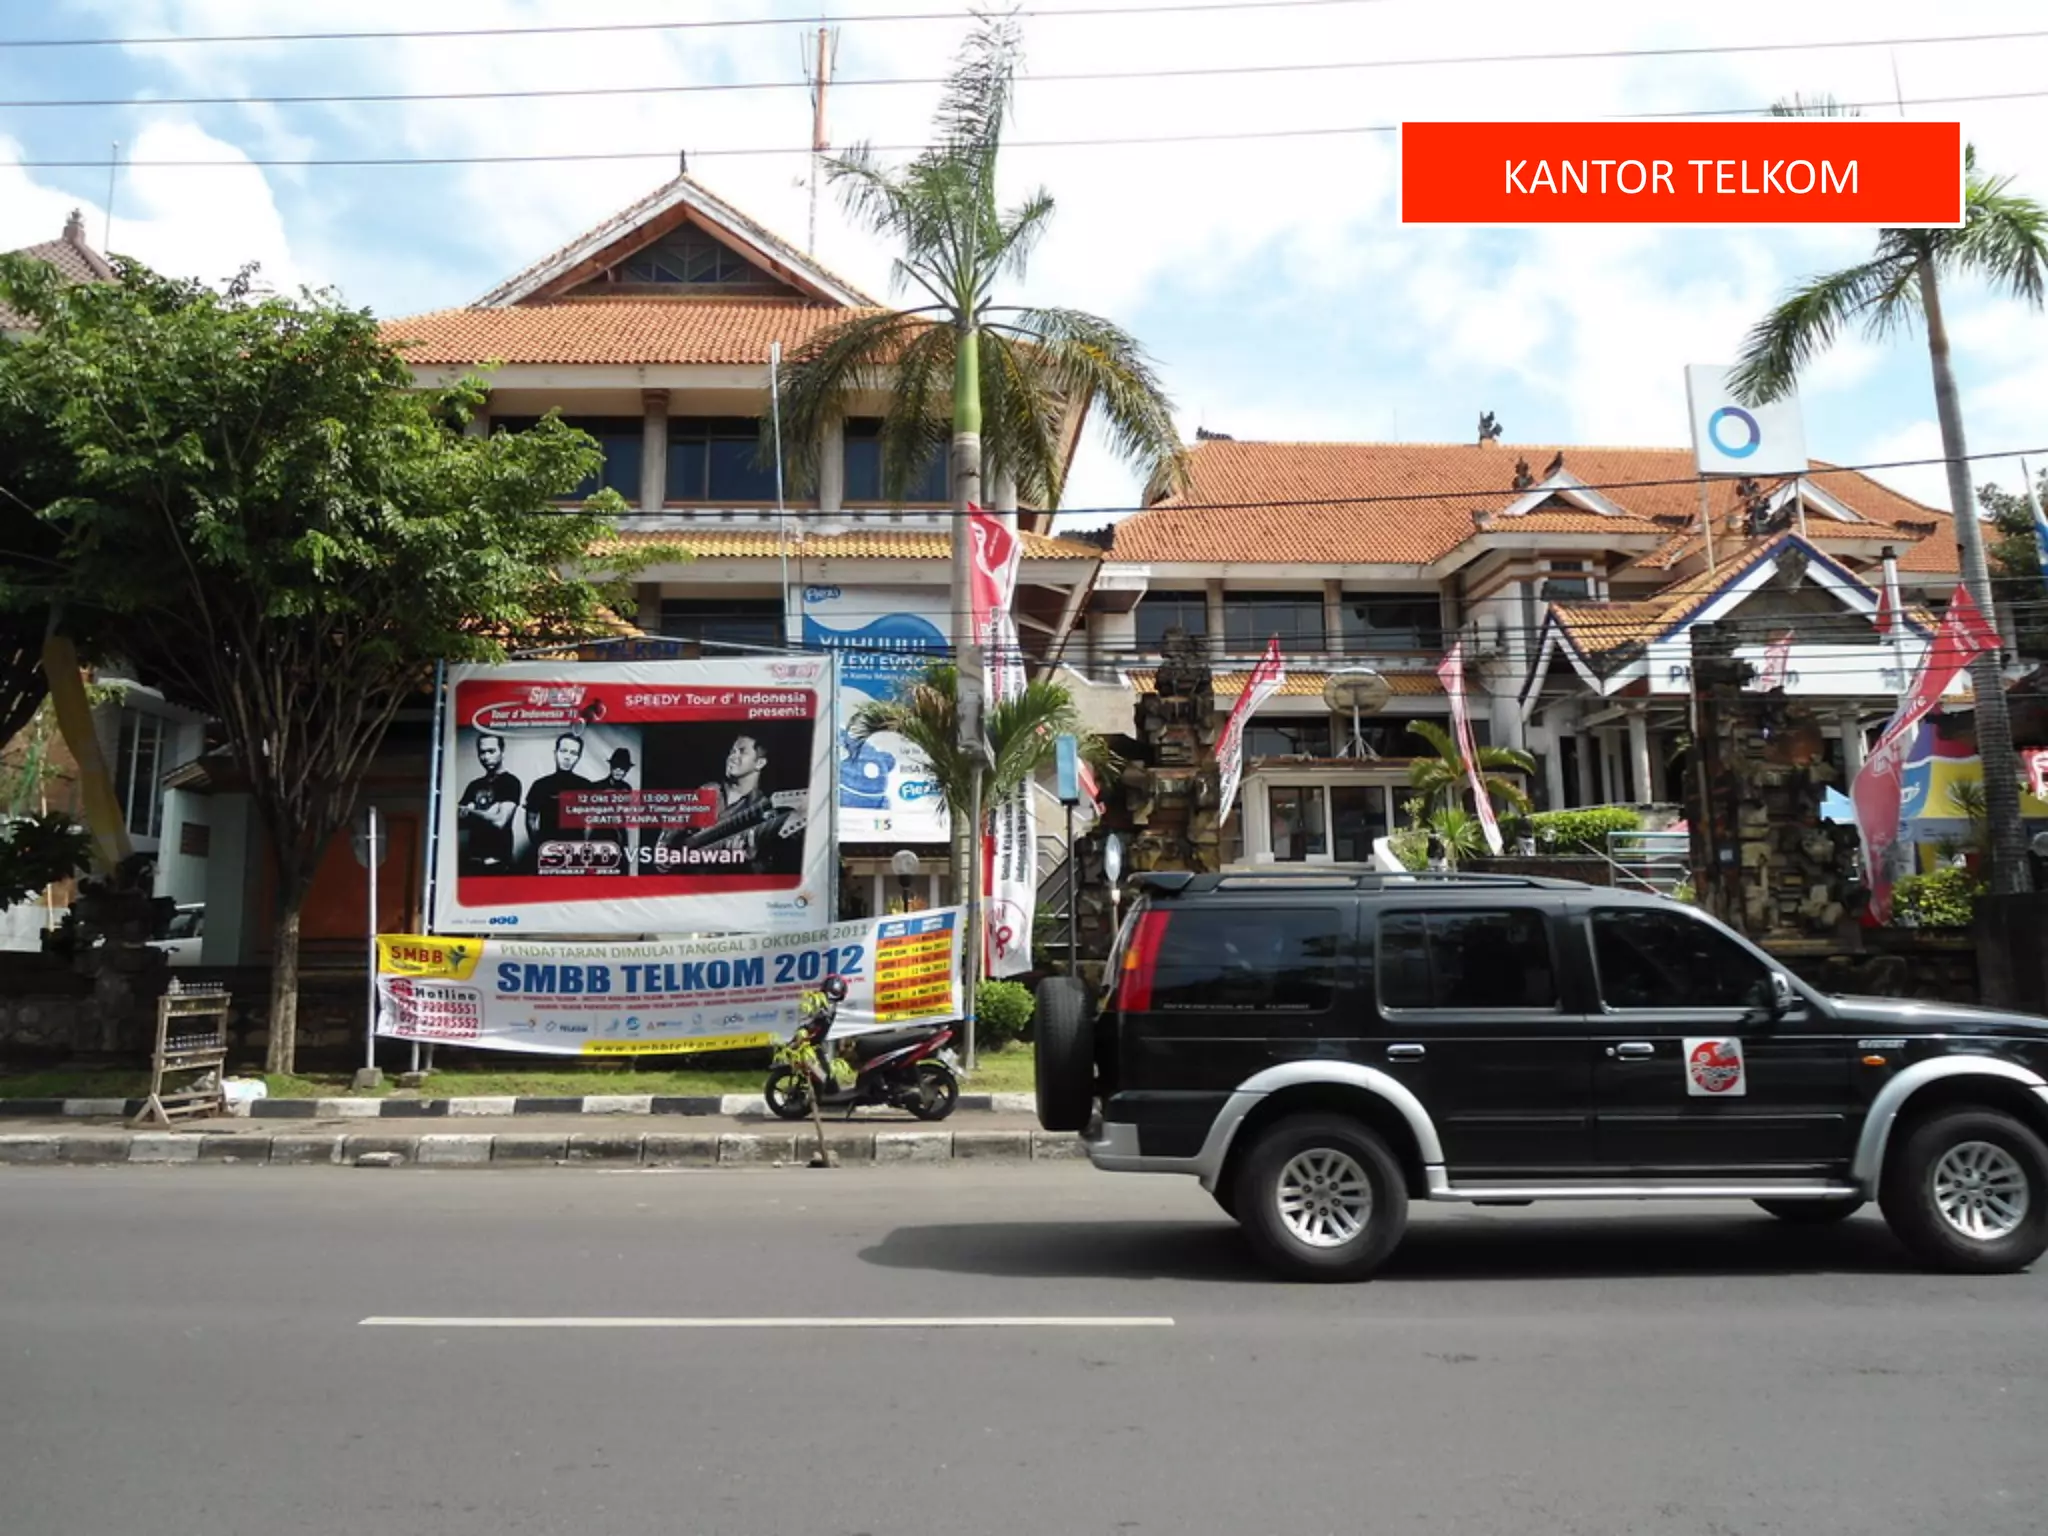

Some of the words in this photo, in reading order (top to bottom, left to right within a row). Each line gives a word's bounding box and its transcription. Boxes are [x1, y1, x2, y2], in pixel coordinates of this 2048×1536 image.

[625, 693, 681, 707] SPEEDY
[686, 692, 717, 705] Tour
[738, 692, 807, 704] Indonesia
[748, 704, 807, 719] presents
[671, 793, 700, 803] WITA
[584, 814, 622, 824] GRATIS
[624, 814, 659, 824] TANPA
[661, 814, 691, 823] TIKET
[654, 844, 745, 864] Balawan
[501, 944, 607, 959] PENDAFTARAN
[611, 945, 675, 959] DIMULAI
[677, 939, 746, 956] TANGGAL
[750, 938, 758, 950] 3
[761, 930, 830, 949] OKTOBER
[832, 924, 869, 939] 2011
[391, 946, 443, 964] SMBB
[497, 962, 611, 994] SMBB
[620, 956, 765, 993] TELKOM
[774, 944, 867, 984] 2012
[415, 987, 478, 1001] Hotline
